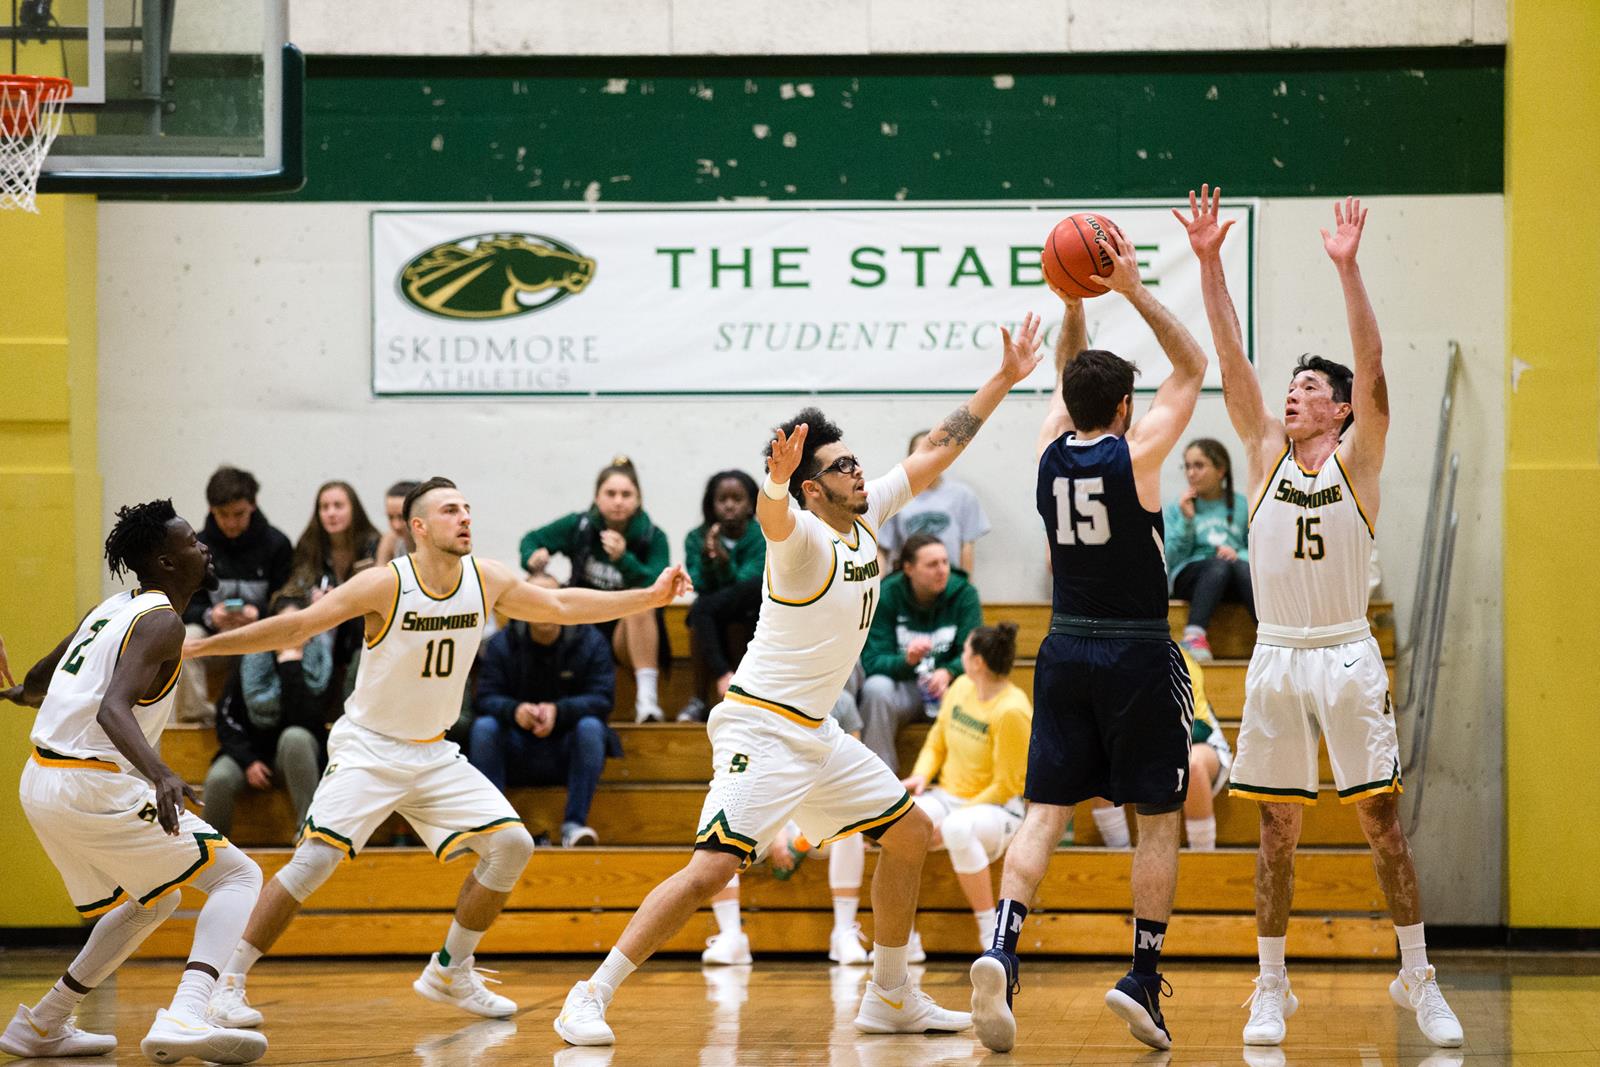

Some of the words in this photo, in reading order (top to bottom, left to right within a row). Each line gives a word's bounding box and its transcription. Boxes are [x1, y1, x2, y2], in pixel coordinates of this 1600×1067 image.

[655, 247, 811, 289] THE
[850, 245, 1159, 289] STABE
[388, 335, 600, 365] SKIDMORE
[713, 321, 908, 352] STUDENT
[919, 319, 1101, 352] SECTON
[419, 367, 572, 389] ATHLETICS
[1052, 476, 1112, 546] 15
[1294, 516, 1325, 561] 15
[401, 611, 479, 632] SKIDMORE
[859, 587, 873, 631] 11
[61, 618, 111, 676] 2
[421, 638, 455, 678] 10
[729, 753, 749, 774] S
[1138, 929, 1166, 951] M
